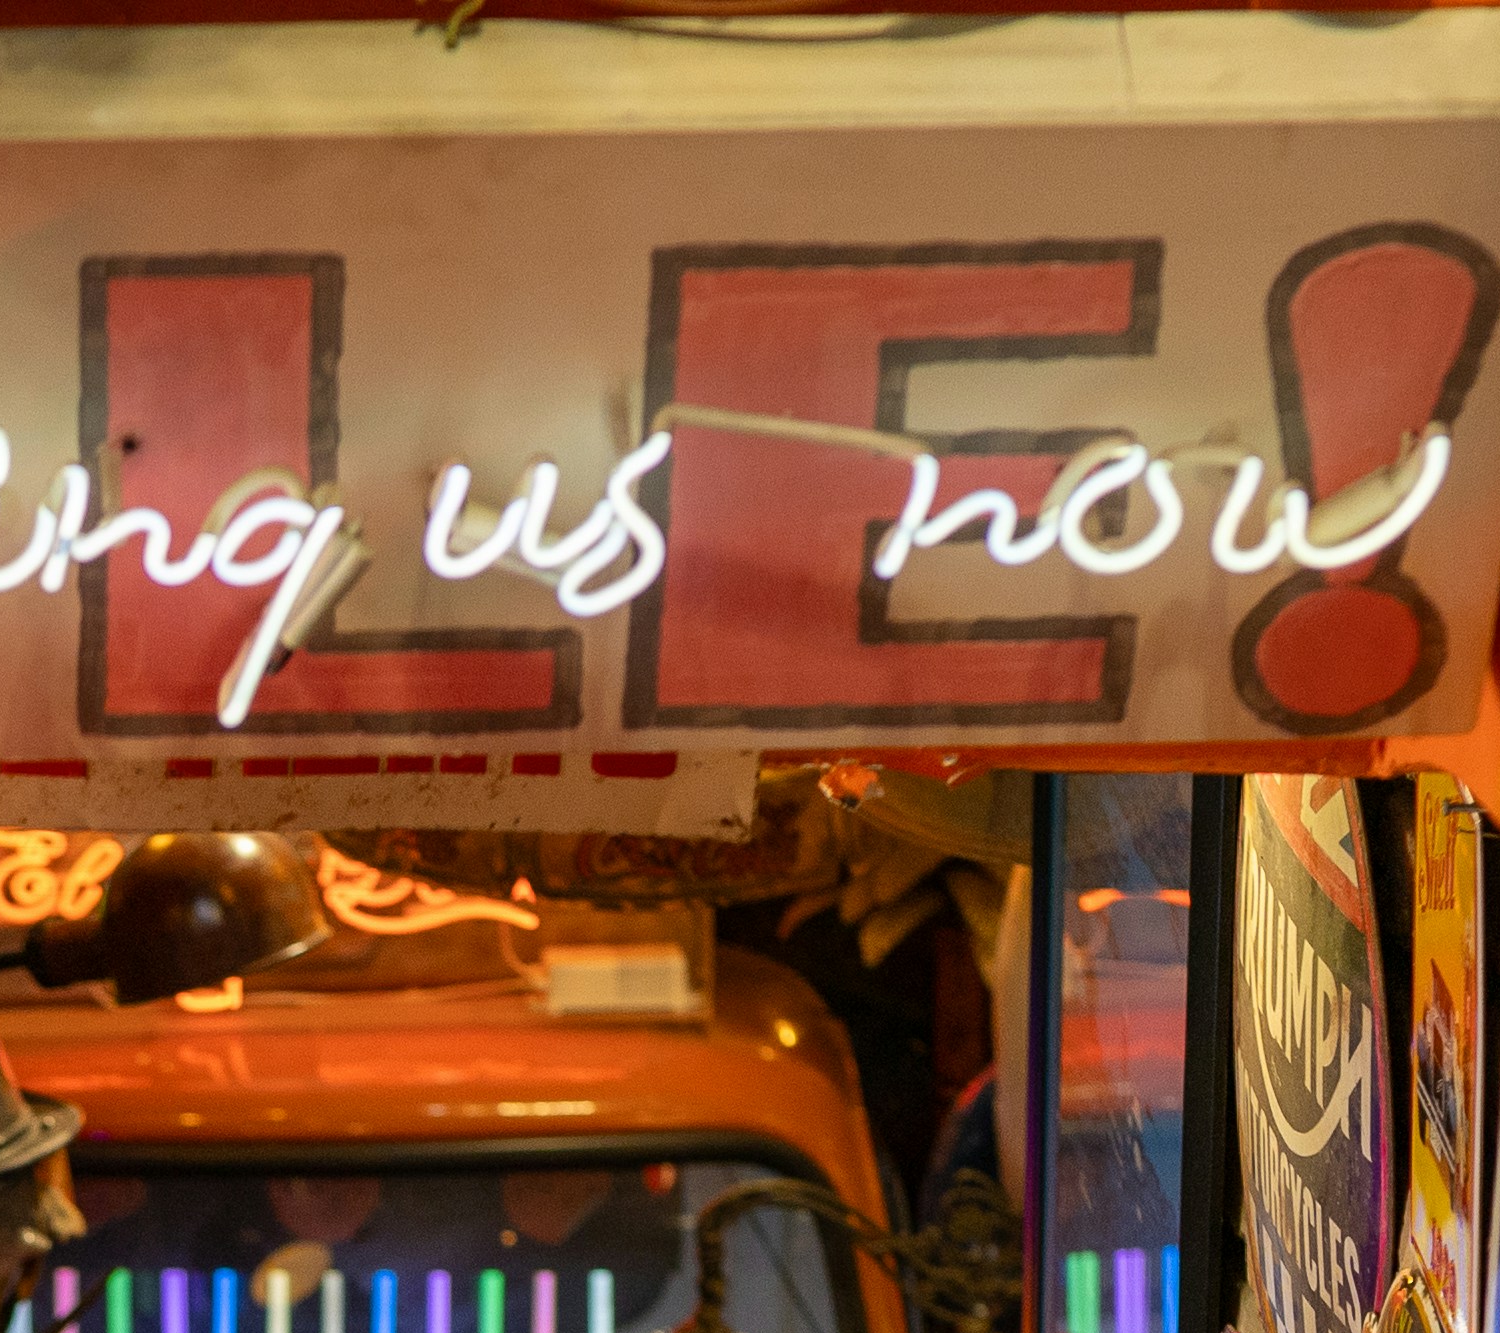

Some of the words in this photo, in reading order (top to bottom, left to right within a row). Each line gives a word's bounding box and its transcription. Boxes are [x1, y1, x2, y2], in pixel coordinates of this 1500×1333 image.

[424, 428, 678, 617] us
[874, 426, 1453, 578] now
[1239, 820, 1374, 1164] TRIUMPH
